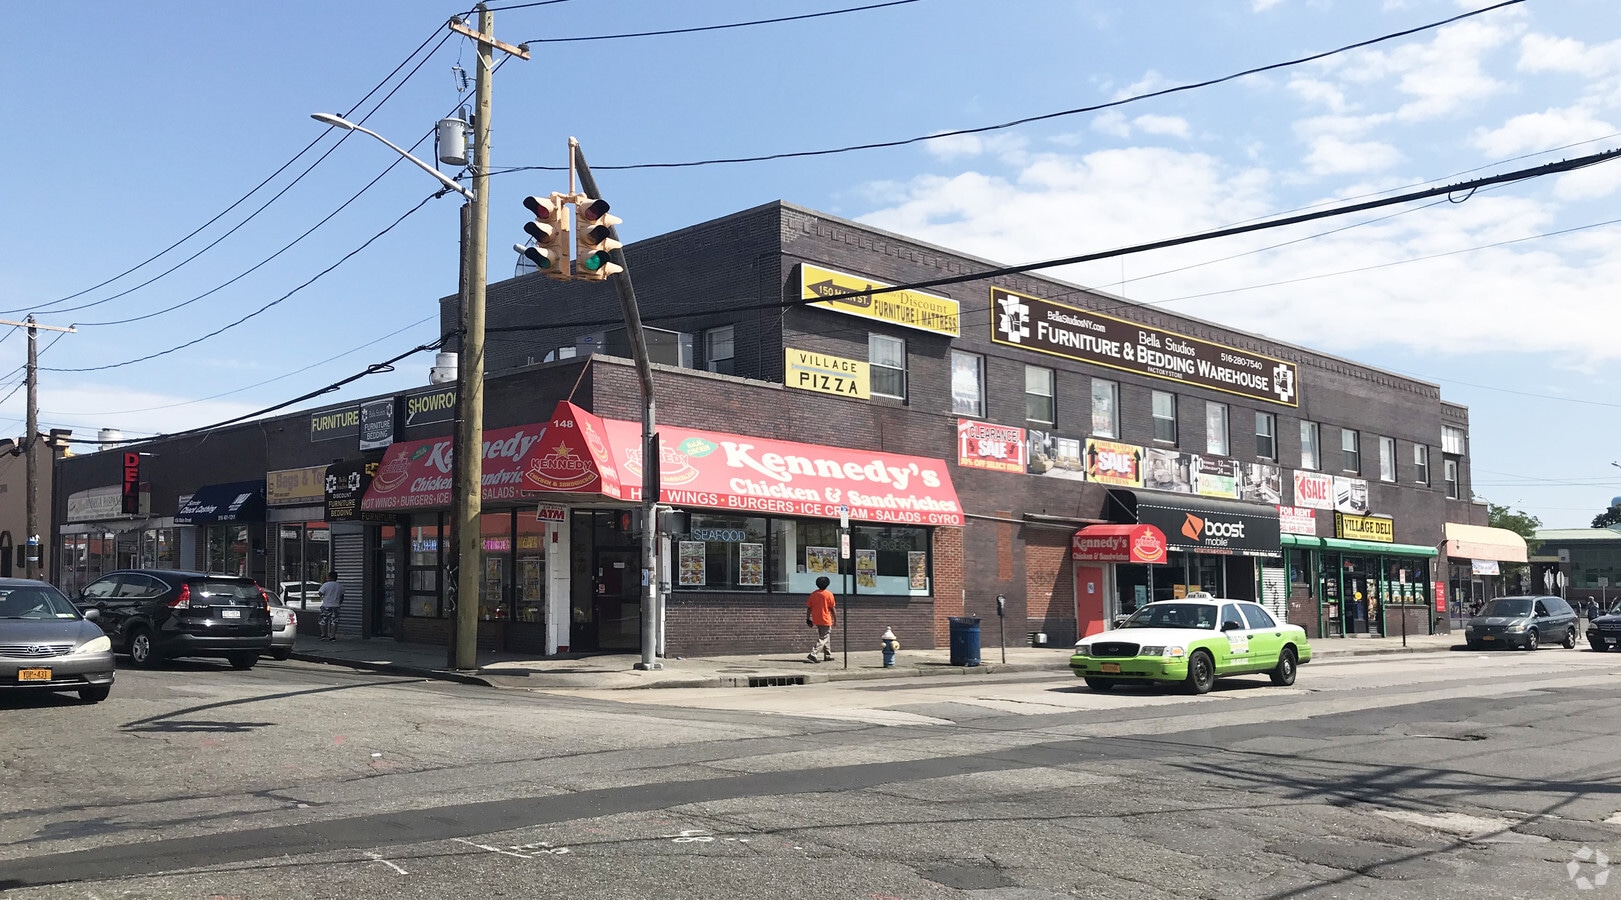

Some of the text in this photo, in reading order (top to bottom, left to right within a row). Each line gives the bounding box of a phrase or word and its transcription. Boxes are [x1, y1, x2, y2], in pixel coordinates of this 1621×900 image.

[819, 285, 834, 298] 150
[900, 292, 948, 315] Discount
[874, 299, 958, 333] FURNITURE MATTRESS
[1047, 310, 1106, 333] BellaStudiosNY.com
[1138, 330, 1196, 357] Bella Studios
[799, 352, 857, 373] VILLAGE
[1037, 320, 1270, 392] FURNITURE & BEDDING WAREHOUSE
[1220, 352, 1263, 370] 516-280-7540
[1147, 365, 1183, 380] FACTORY STORE
[799, 372, 858, 395] PIZZA
[408, 391, 457, 415] SHOWRO
[312, 410, 360, 432] FURNITURE
[364, 419, 391, 431] FURNITURE
[553, 419, 574, 428] 148
[366, 429, 388, 440] BEDDING
[978, 439, 1008, 459] SALE
[530, 457, 592, 470] KENNEDY
[719, 441, 941, 490] Kennedy's
[1098, 451, 1132, 473] SALE
[276, 471, 299, 492] Bags
[302, 470, 309, 486] &
[1306, 479, 1327, 500] SALE
[328, 499, 356, 508] FURNITURE
[361, 497, 375, 510] HOT
[375, 496, 397, 509] WINGS
[401, 494, 433, 506] BURGERS
[436, 492, 449, 504] ICE
[482, 485, 515, 500] SALADS
[729, 477, 958, 512] Chicken & Sandwiches
[330, 509, 353, 517] BEDDING
[538, 509, 565, 519] ATM
[668, 490, 718, 506] WINGS
[729, 494, 794, 513] BURGERS
[800, 502, 821, 515] ICE
[825, 503, 869, 520] CRAM
[875, 509, 921, 524] SALADS
[928, 512, 960, 525] GYRO
[1280, 506, 1312, 518] FOR RENT
[693, 528, 746, 541] SEAFOOD
[1204, 517, 1245, 538] boost
[1344, 518, 1391, 535] VILLAGE DELI
[870, 538, 912, 551] BURGERS
[1072, 536, 1128, 551] Kennedy's
[1205, 537, 1228, 546] mobile
